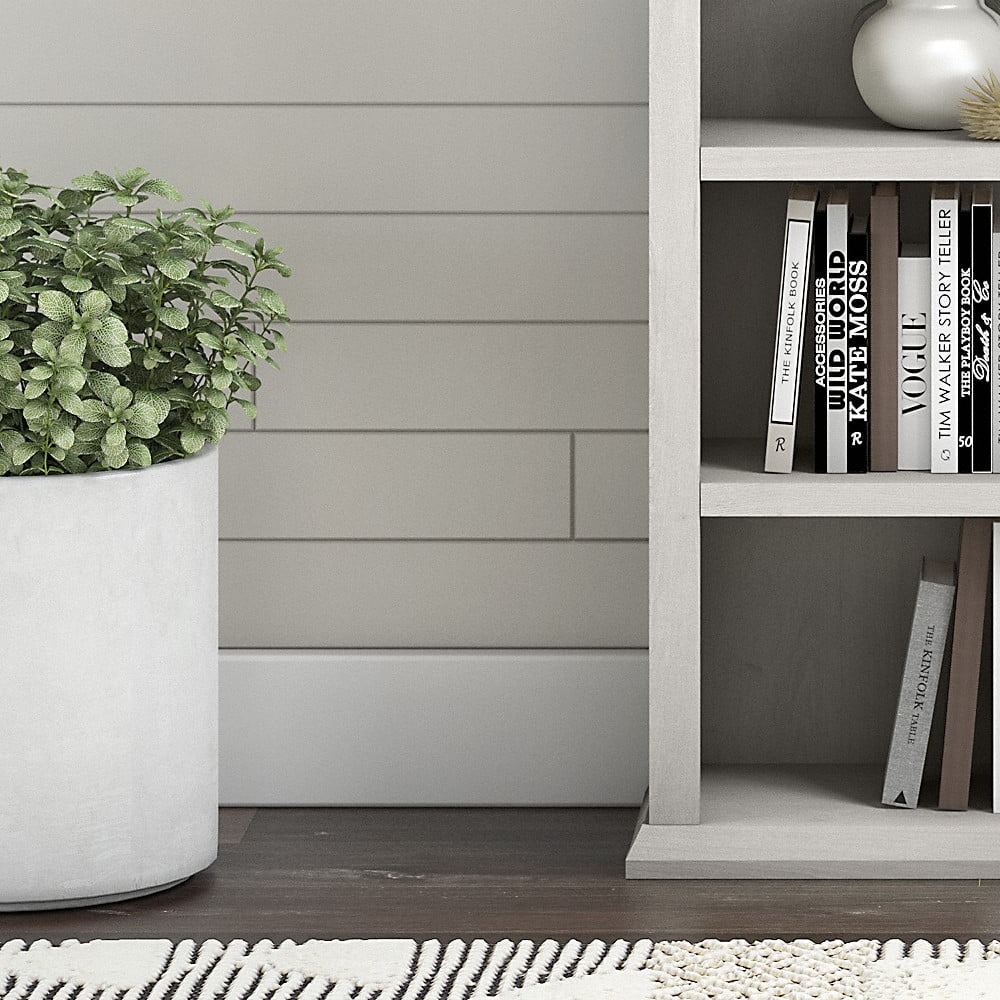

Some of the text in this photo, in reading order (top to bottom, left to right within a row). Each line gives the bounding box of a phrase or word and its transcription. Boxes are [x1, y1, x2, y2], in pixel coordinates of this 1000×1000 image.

[781, 261, 800, 384] THE KINFOLK BOOK
[815, 277, 826, 387] ACCESSORIES
[828, 250, 846, 410] WILD WORLD
[849, 260, 867, 421] KATE MOSS
[901, 312, 927, 415] VOGUE
[938, 209, 951, 439] TIM WALKER STORY TELLER
[961, 268, 971, 397] THE PLAYBOY BOOK
[972, 322, 990, 382] Death
[958, 435, 972, 448] 50
[907, 625, 935, 745] THE KINFOLK TABLE
